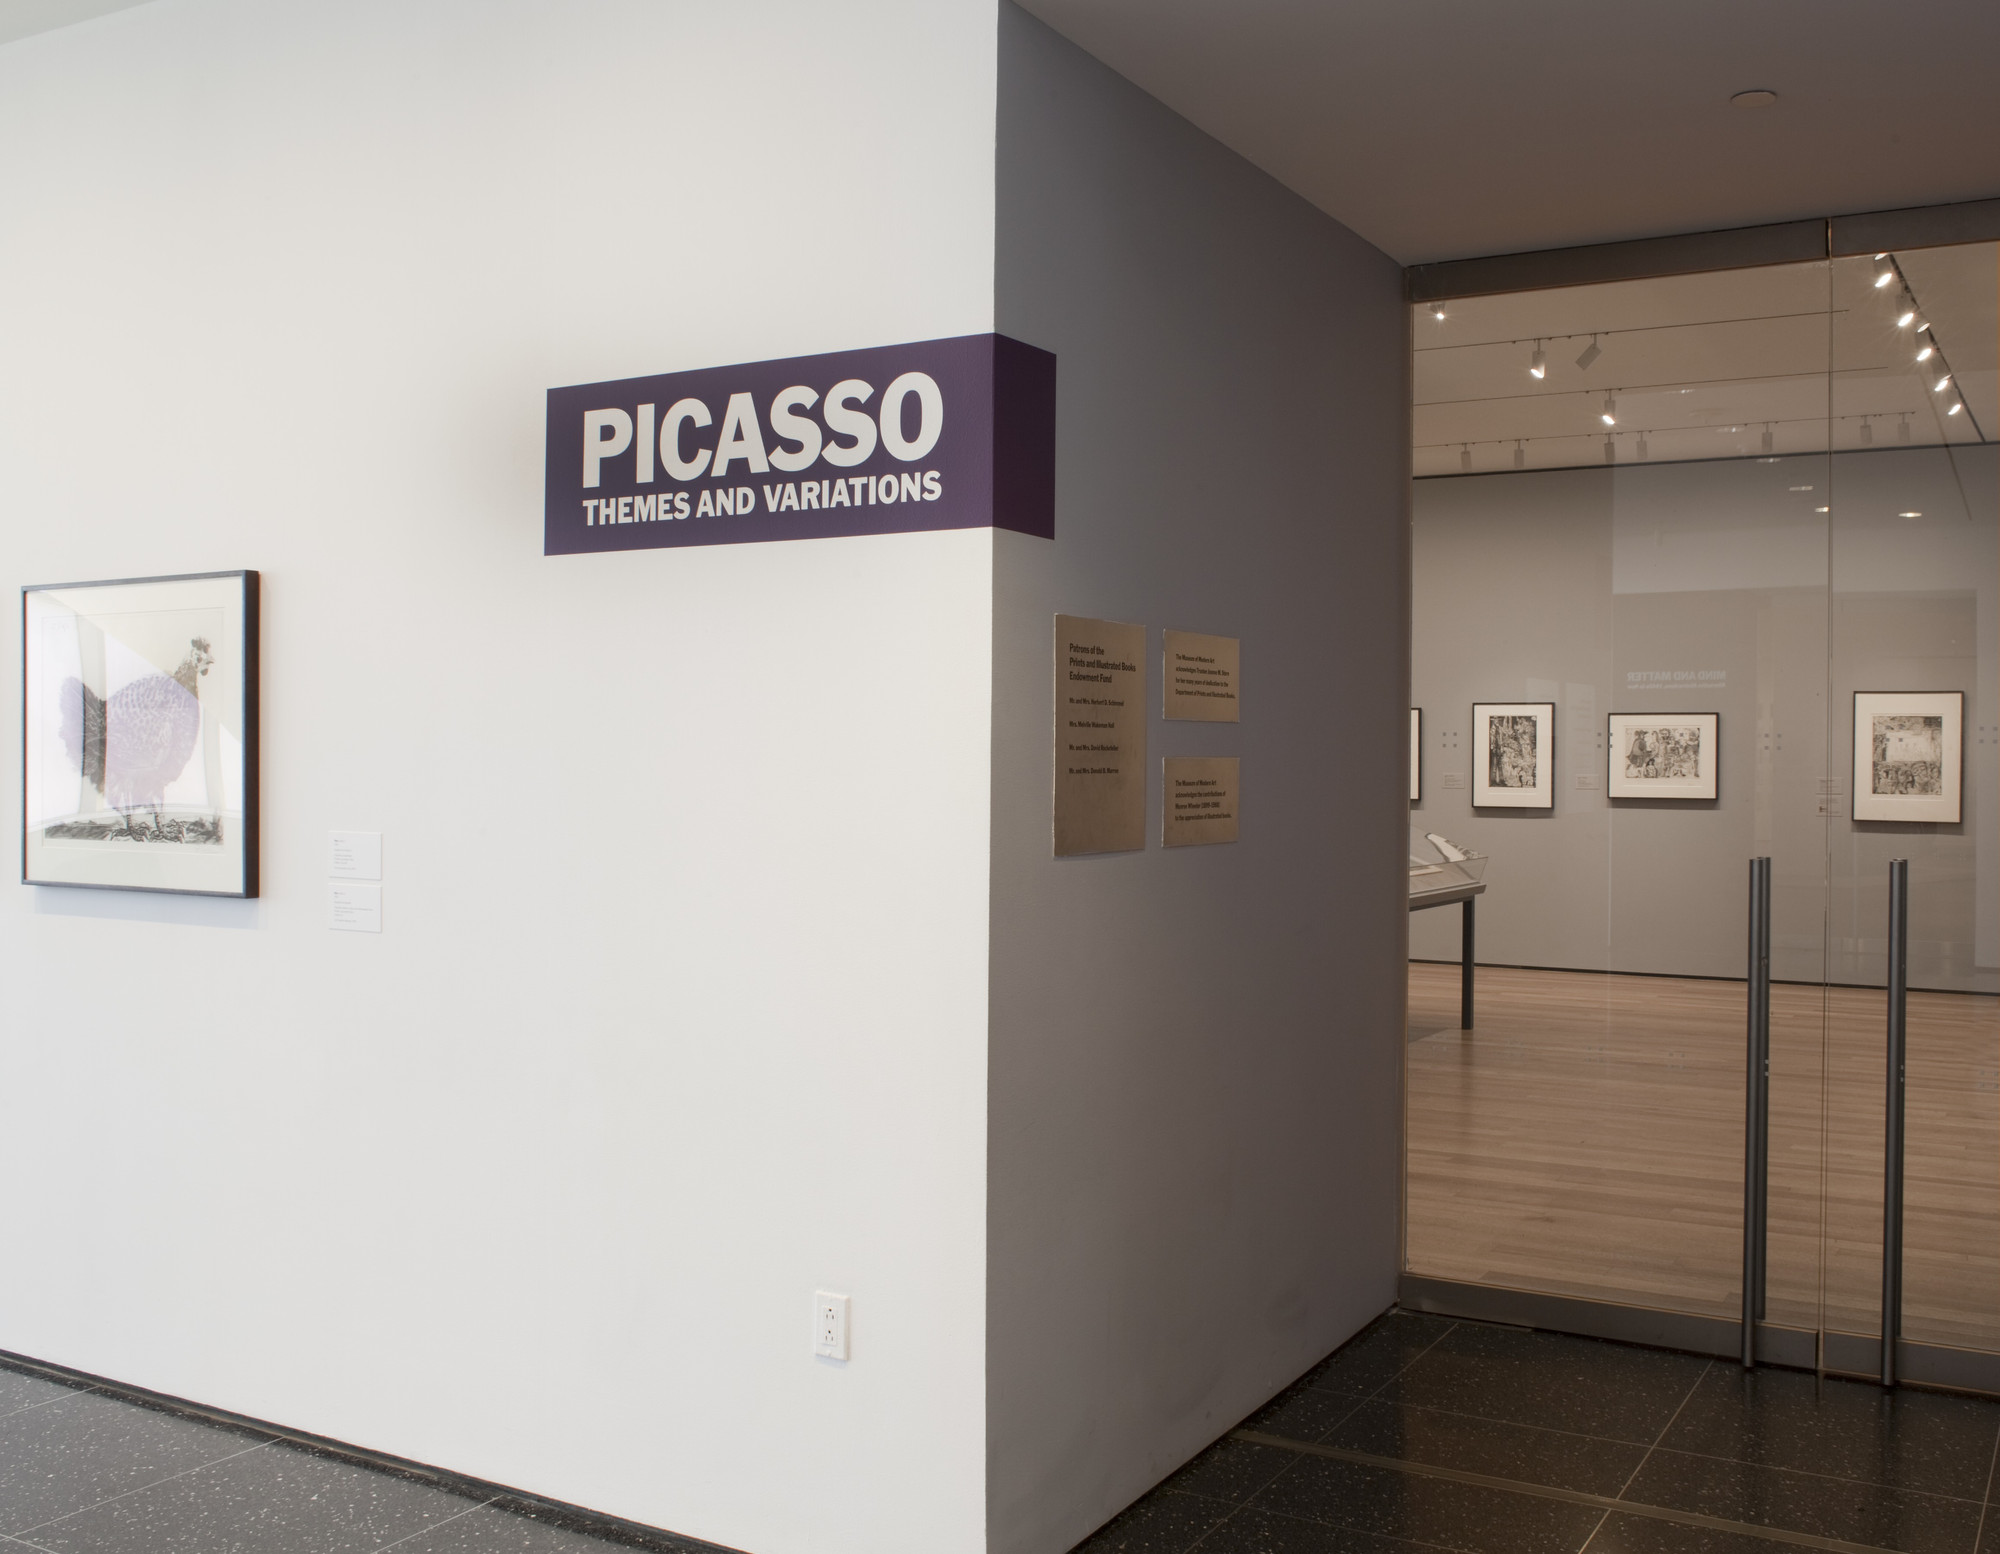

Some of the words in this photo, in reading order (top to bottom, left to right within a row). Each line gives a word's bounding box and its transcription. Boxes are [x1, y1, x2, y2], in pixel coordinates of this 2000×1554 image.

[583, 371, 943, 488] PICASSO
[583, 492, 691, 526] THEMES
[696, 486, 756, 518] AND
[763, 470, 942, 513] VARIATIONS
[1069, 643, 1089, 654] Patrons
[1090, 645, 1095, 655] of
[1096, 646, 1104, 655] the
[1069, 657, 1085, 667] Prints
[1086, 659, 1095, 668] and
[1121, 662, 1136, 672] Books
[1069, 671, 1099, 682] Endowment
[1100, 673, 1112, 683] Fund
